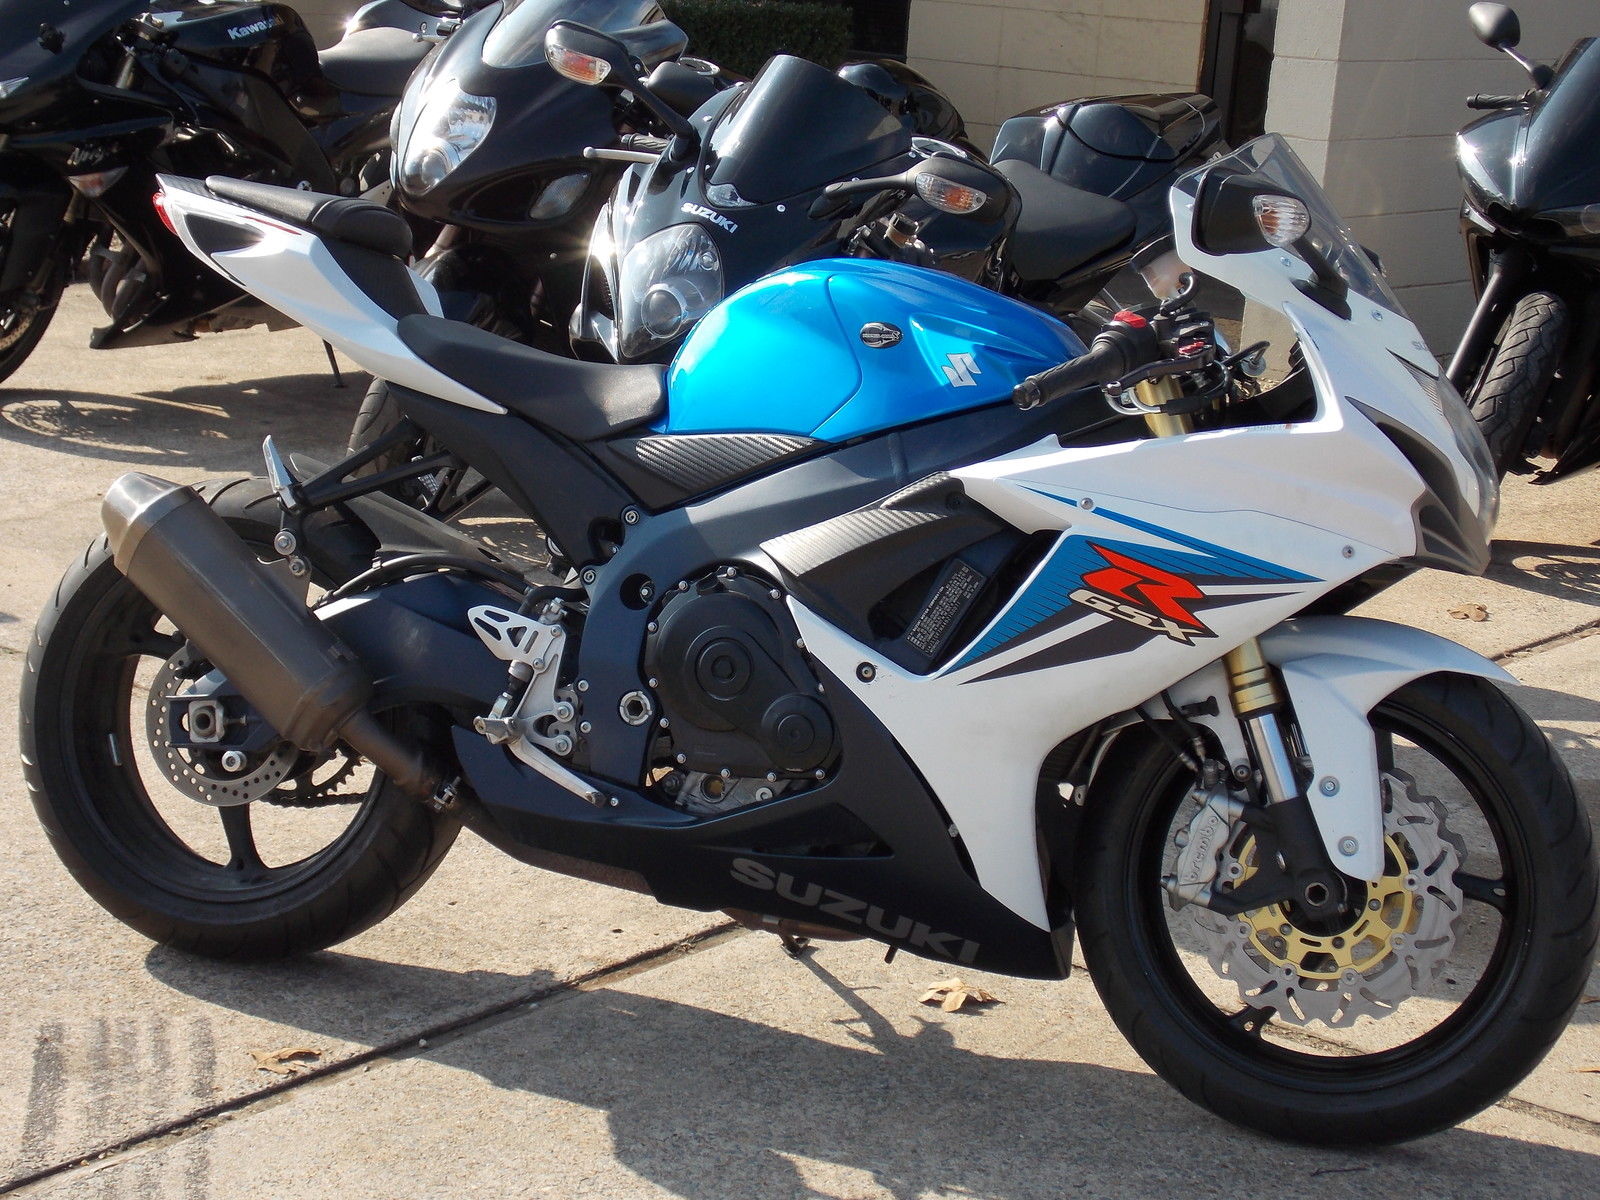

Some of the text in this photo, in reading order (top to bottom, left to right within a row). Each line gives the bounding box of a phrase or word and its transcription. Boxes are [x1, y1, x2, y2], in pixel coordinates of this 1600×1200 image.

[681, 202, 738, 233] SUZUKI
[1068, 588, 1203, 641] GSX
[1188, 815, 1219, 880] brembo
[729, 857, 981, 964] SUZUKI
